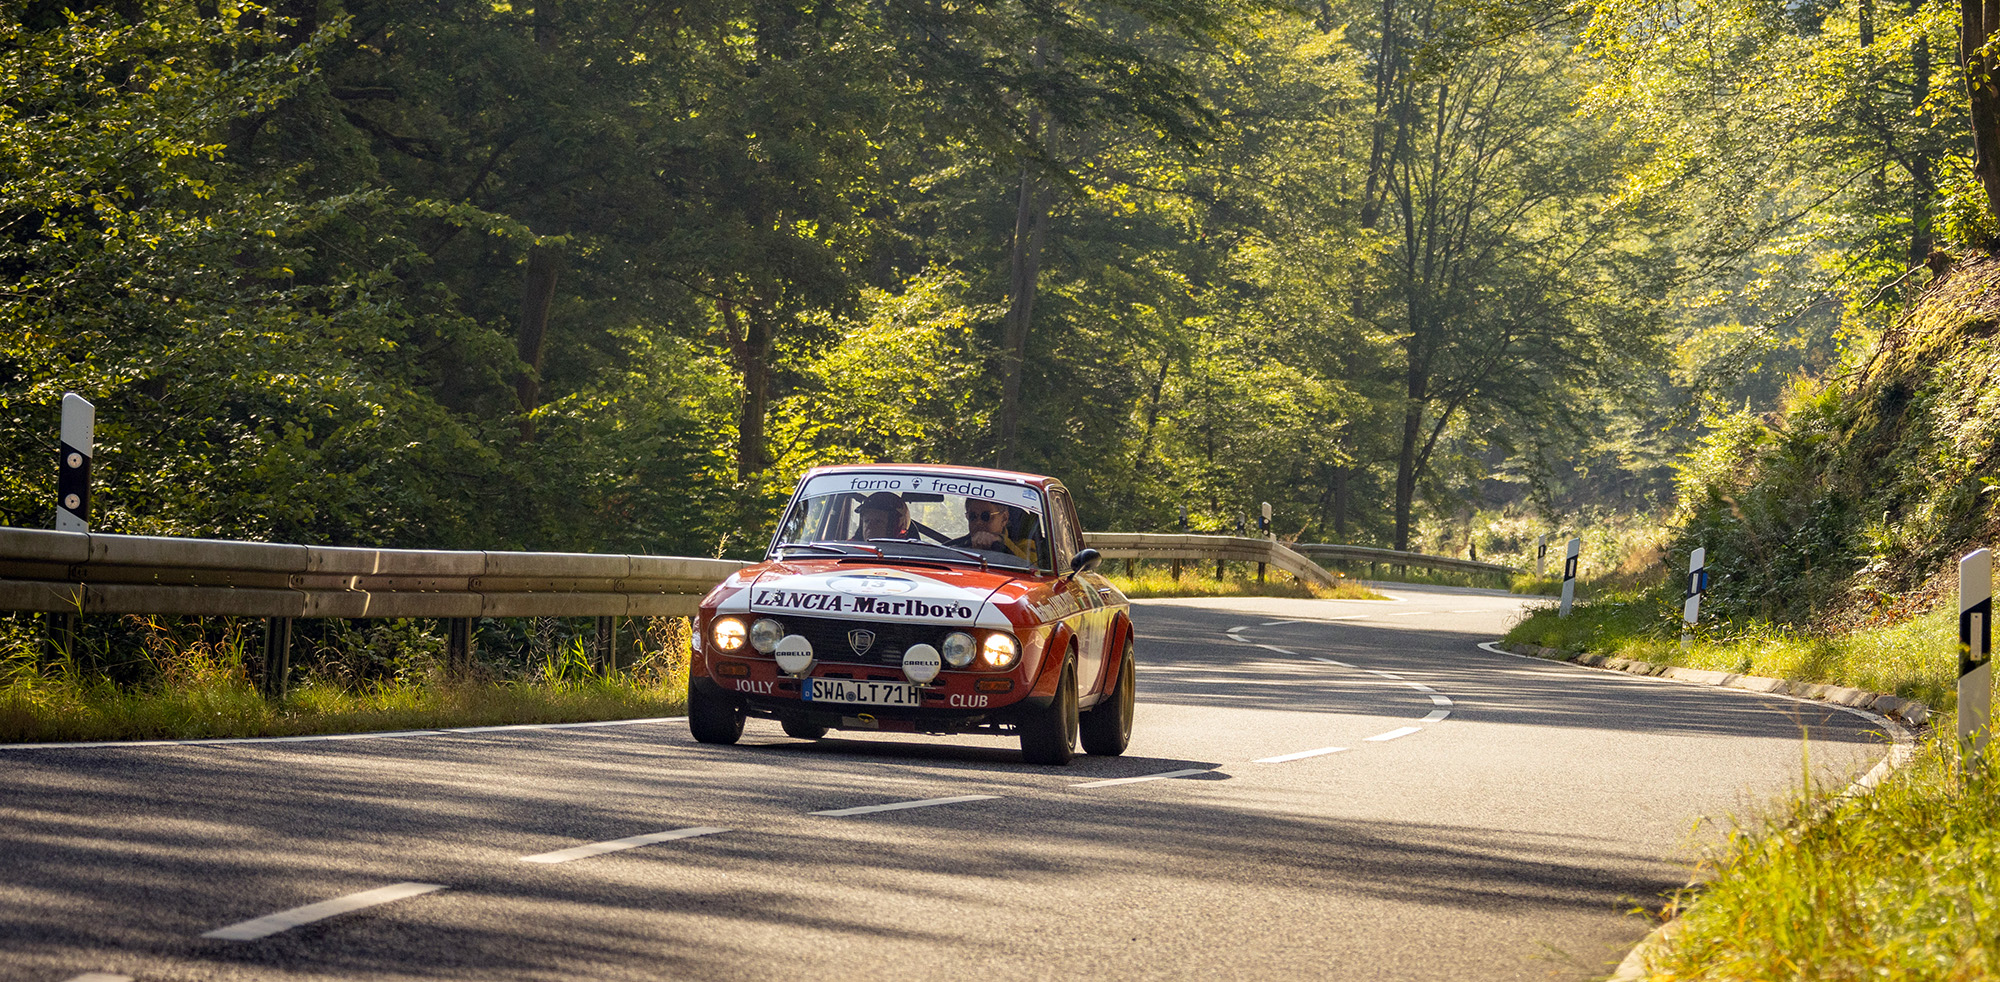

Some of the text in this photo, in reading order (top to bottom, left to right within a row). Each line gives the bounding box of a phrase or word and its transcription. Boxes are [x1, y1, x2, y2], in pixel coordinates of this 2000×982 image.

[850, 477, 996, 499] forno freddo
[861, 580, 886, 588] 13
[735, 679, 774, 694] JOLLY
[813, 681, 845, 701] SWA
[950, 694, 988, 708] CLUB
